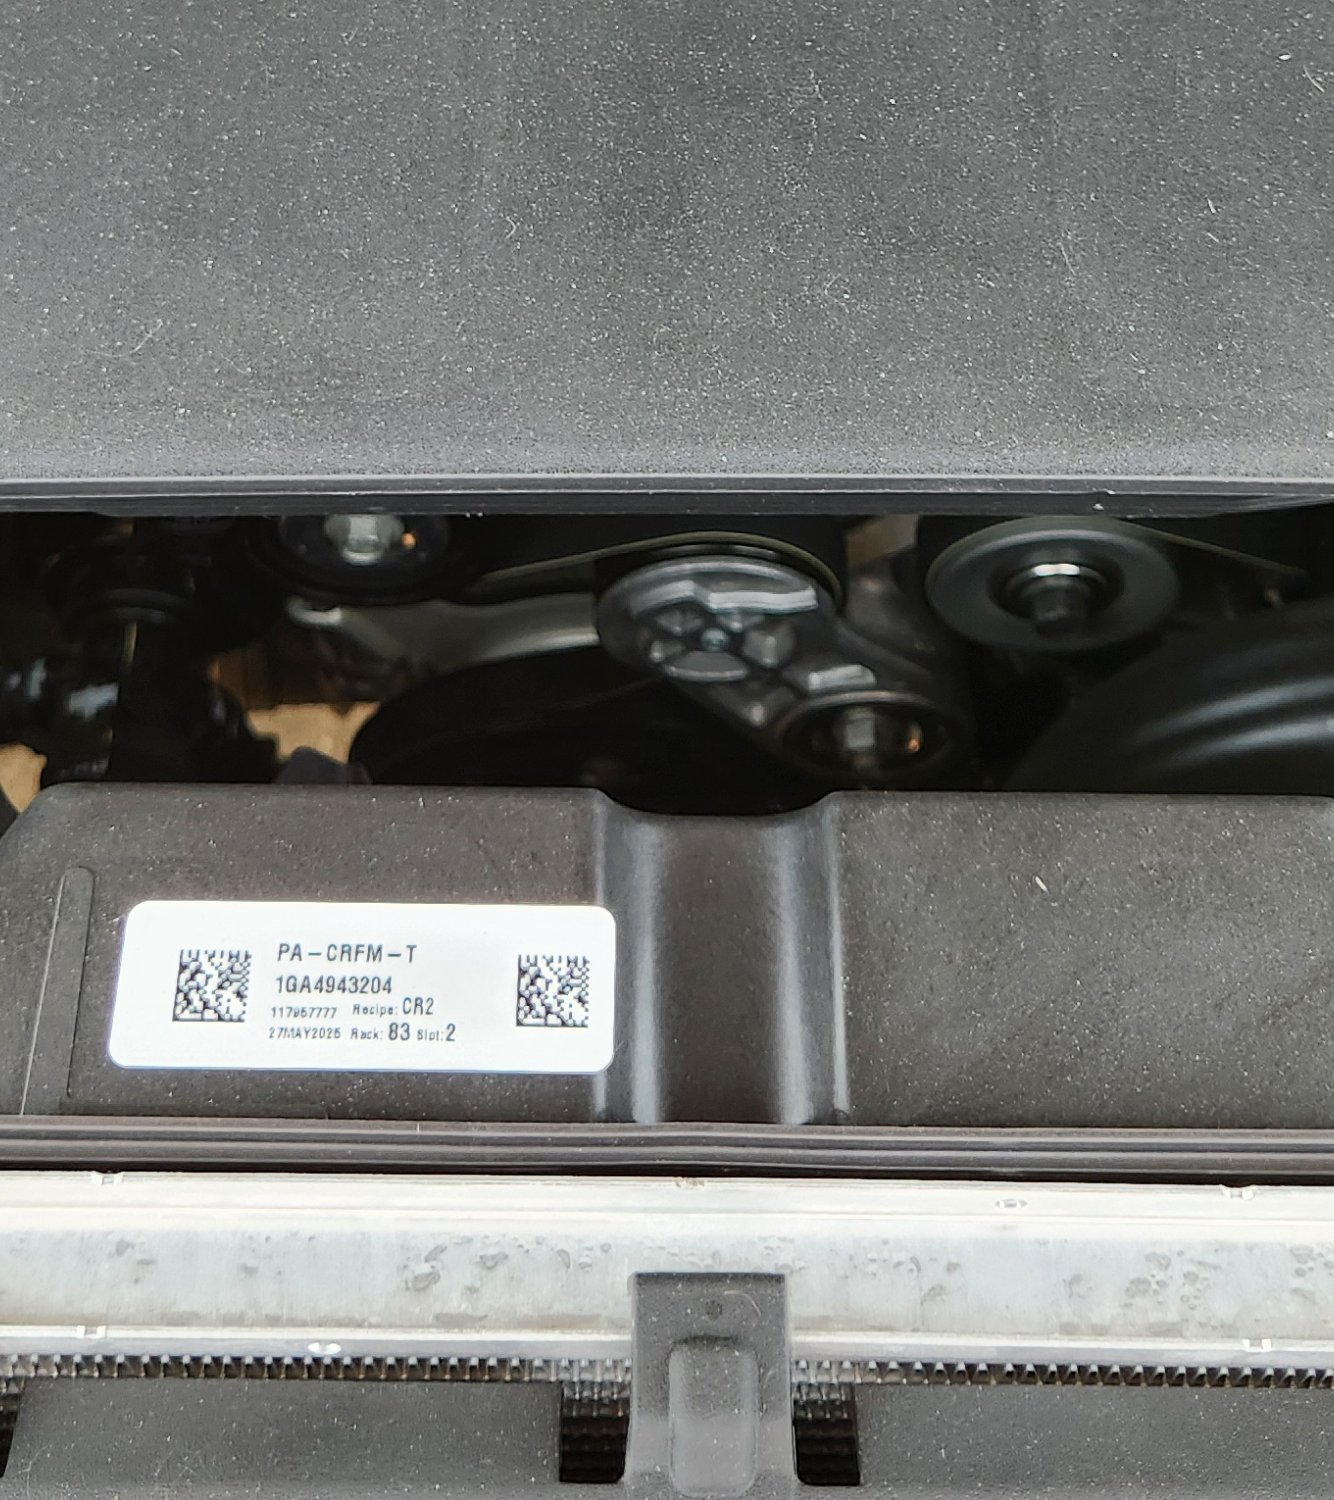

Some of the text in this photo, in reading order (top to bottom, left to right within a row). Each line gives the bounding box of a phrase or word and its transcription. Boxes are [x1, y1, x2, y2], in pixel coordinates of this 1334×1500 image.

[277, 943, 417, 963] PA-CRFM-T
[275, 975, 392, 994] 1GA4943204
[352, 1003, 398, 1017] Recipe:
[402, 997, 435, 1015] CR2
[350, 1027, 384, 1040] Rack:
[388, 1022, 411, 1041] 83
